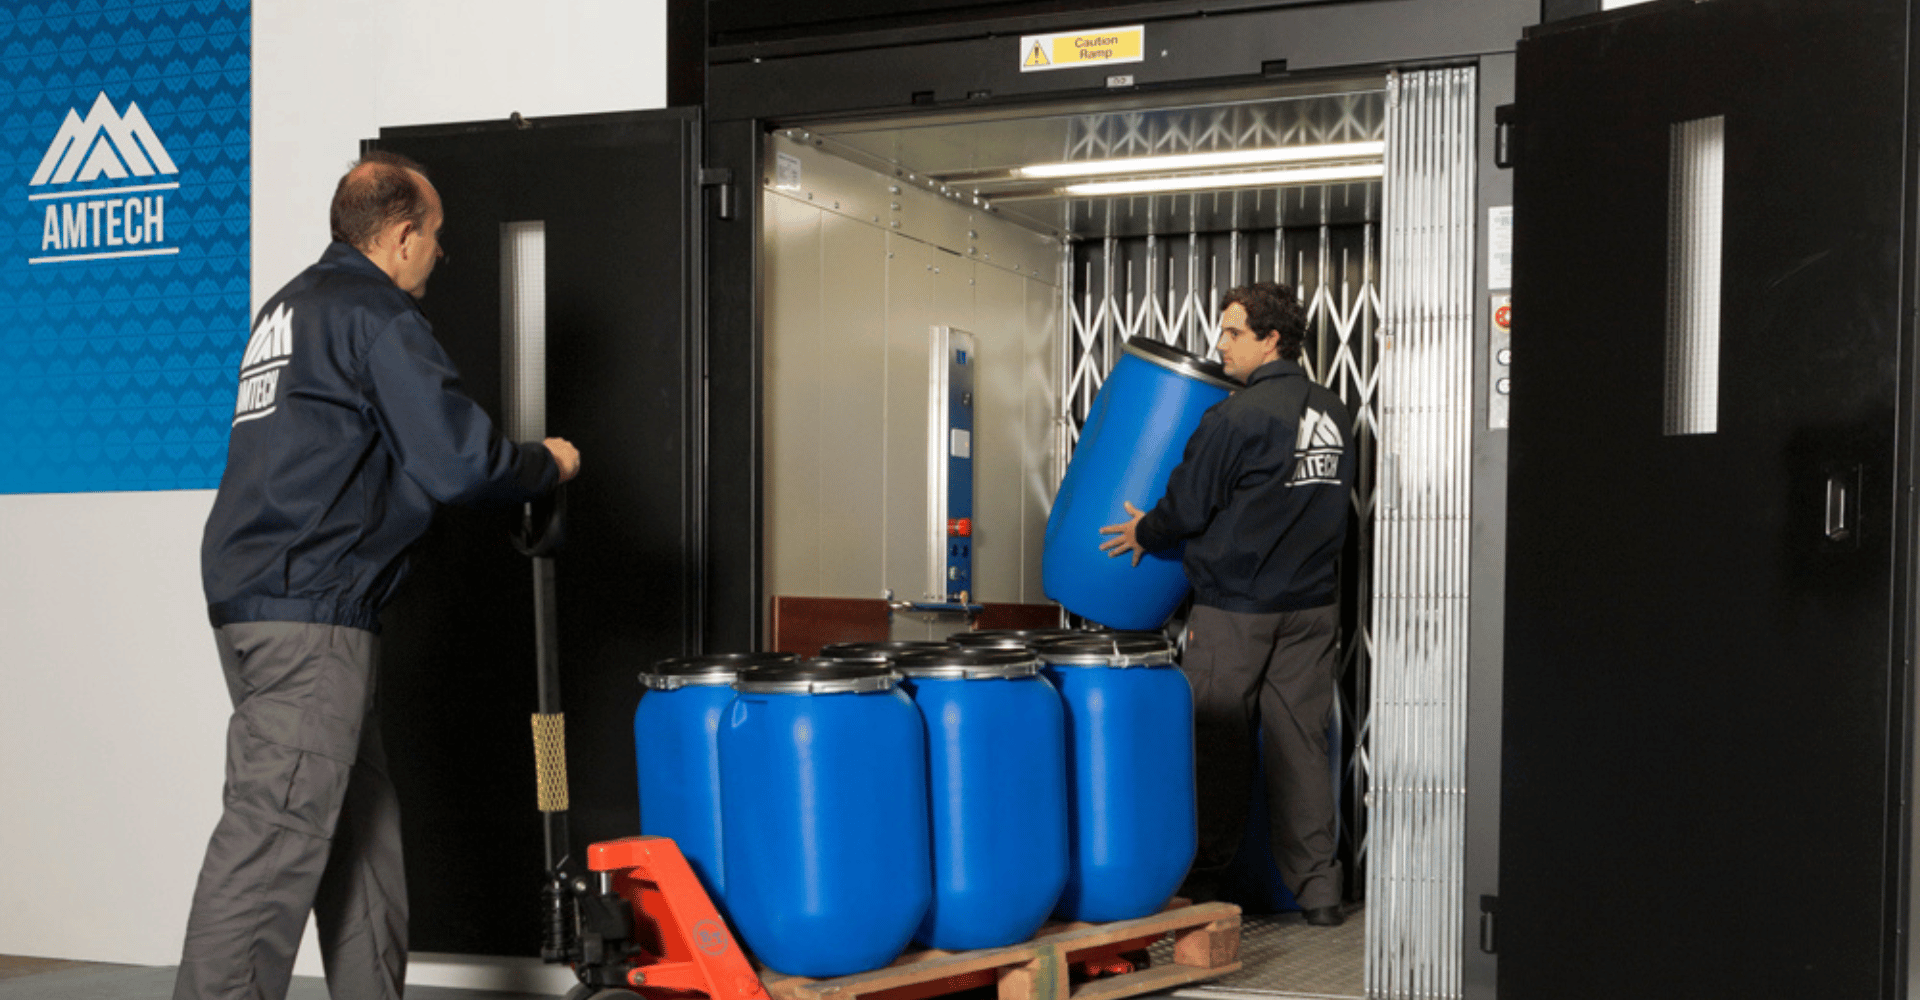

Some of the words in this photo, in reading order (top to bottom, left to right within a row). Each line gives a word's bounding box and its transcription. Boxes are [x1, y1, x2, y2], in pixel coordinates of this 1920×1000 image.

[1074, 36, 1119, 49] Caution
[1079, 48, 1113, 60] Ramp
[41, 195, 164, 251] AMTECH
